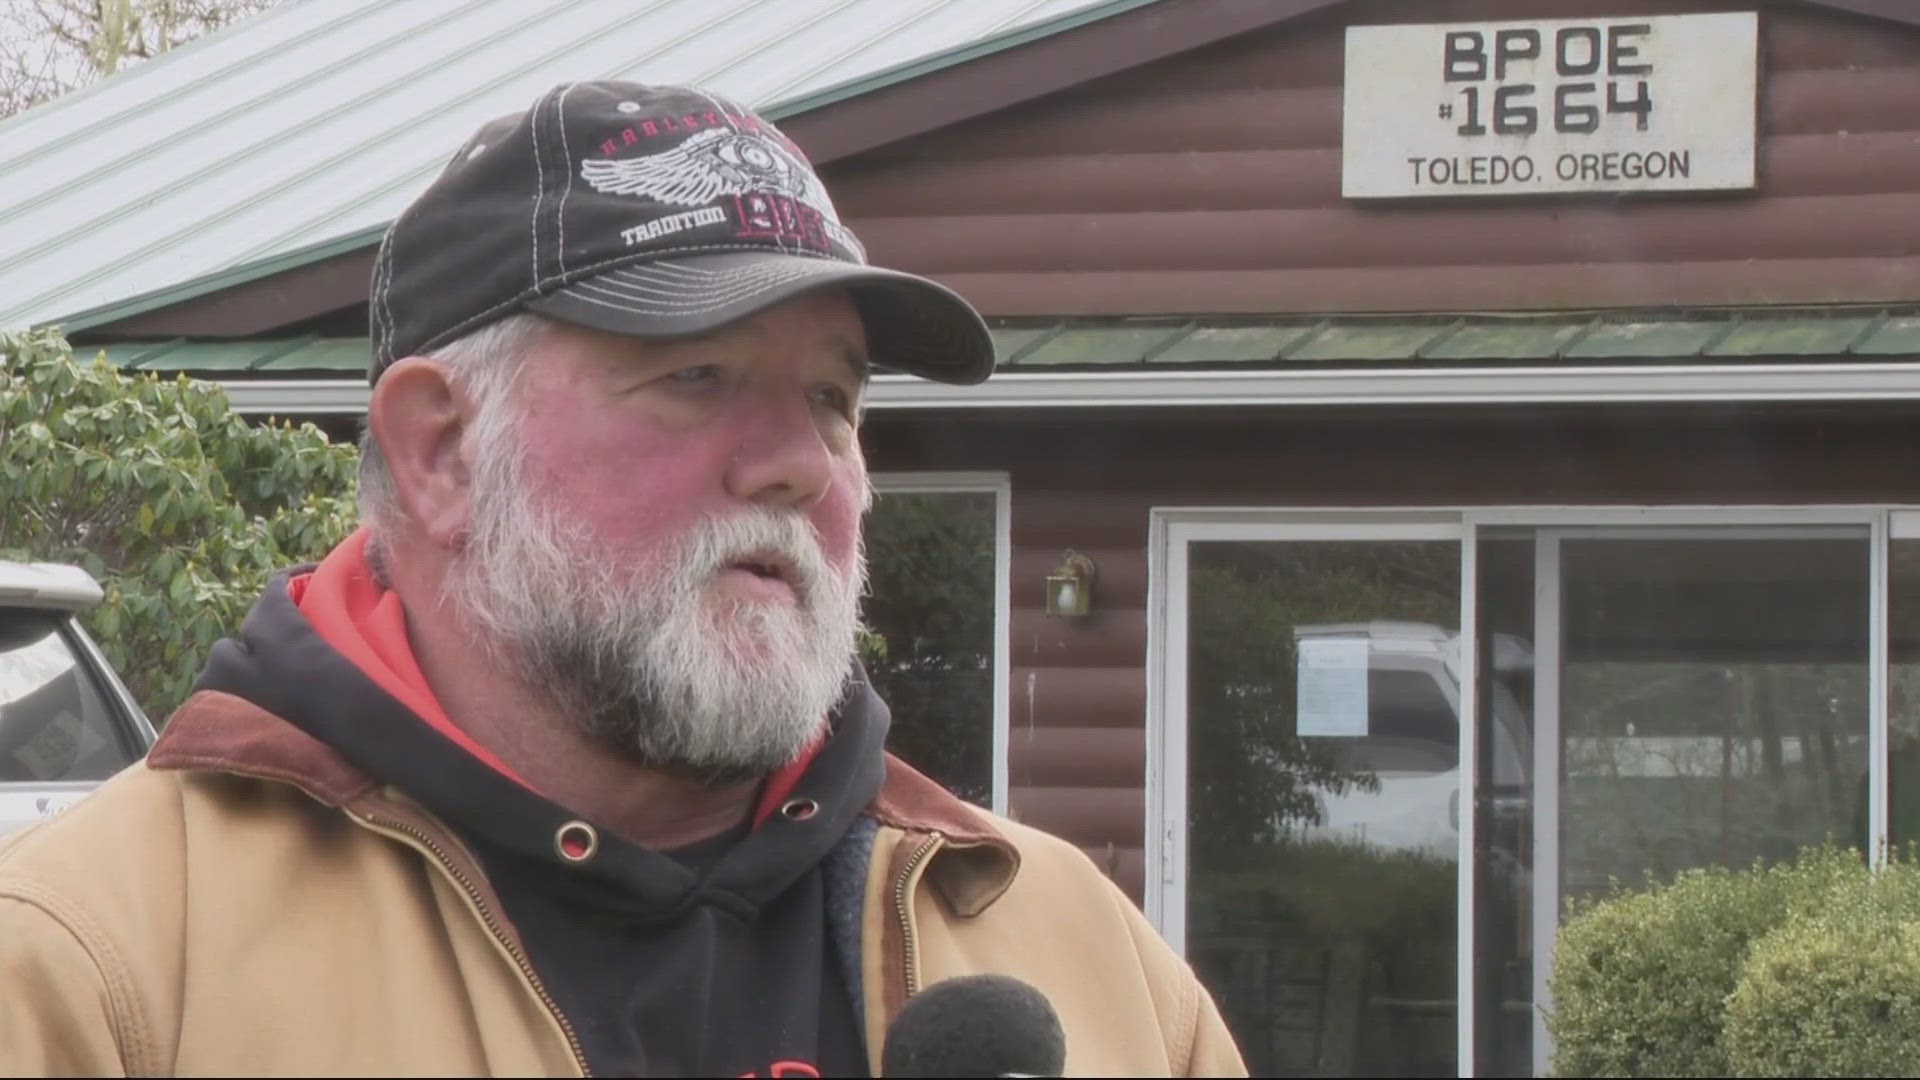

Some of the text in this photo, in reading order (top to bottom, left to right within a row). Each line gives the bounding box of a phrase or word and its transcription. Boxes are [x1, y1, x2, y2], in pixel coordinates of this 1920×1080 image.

[1443, 24, 1653, 82] BPOE
[1439, 82, 1652, 136] #1664
[601, 112, 718, 156] HARLEY
[1556, 150, 1690, 181] OREGON
[620, 205, 727, 246] TRADITION
